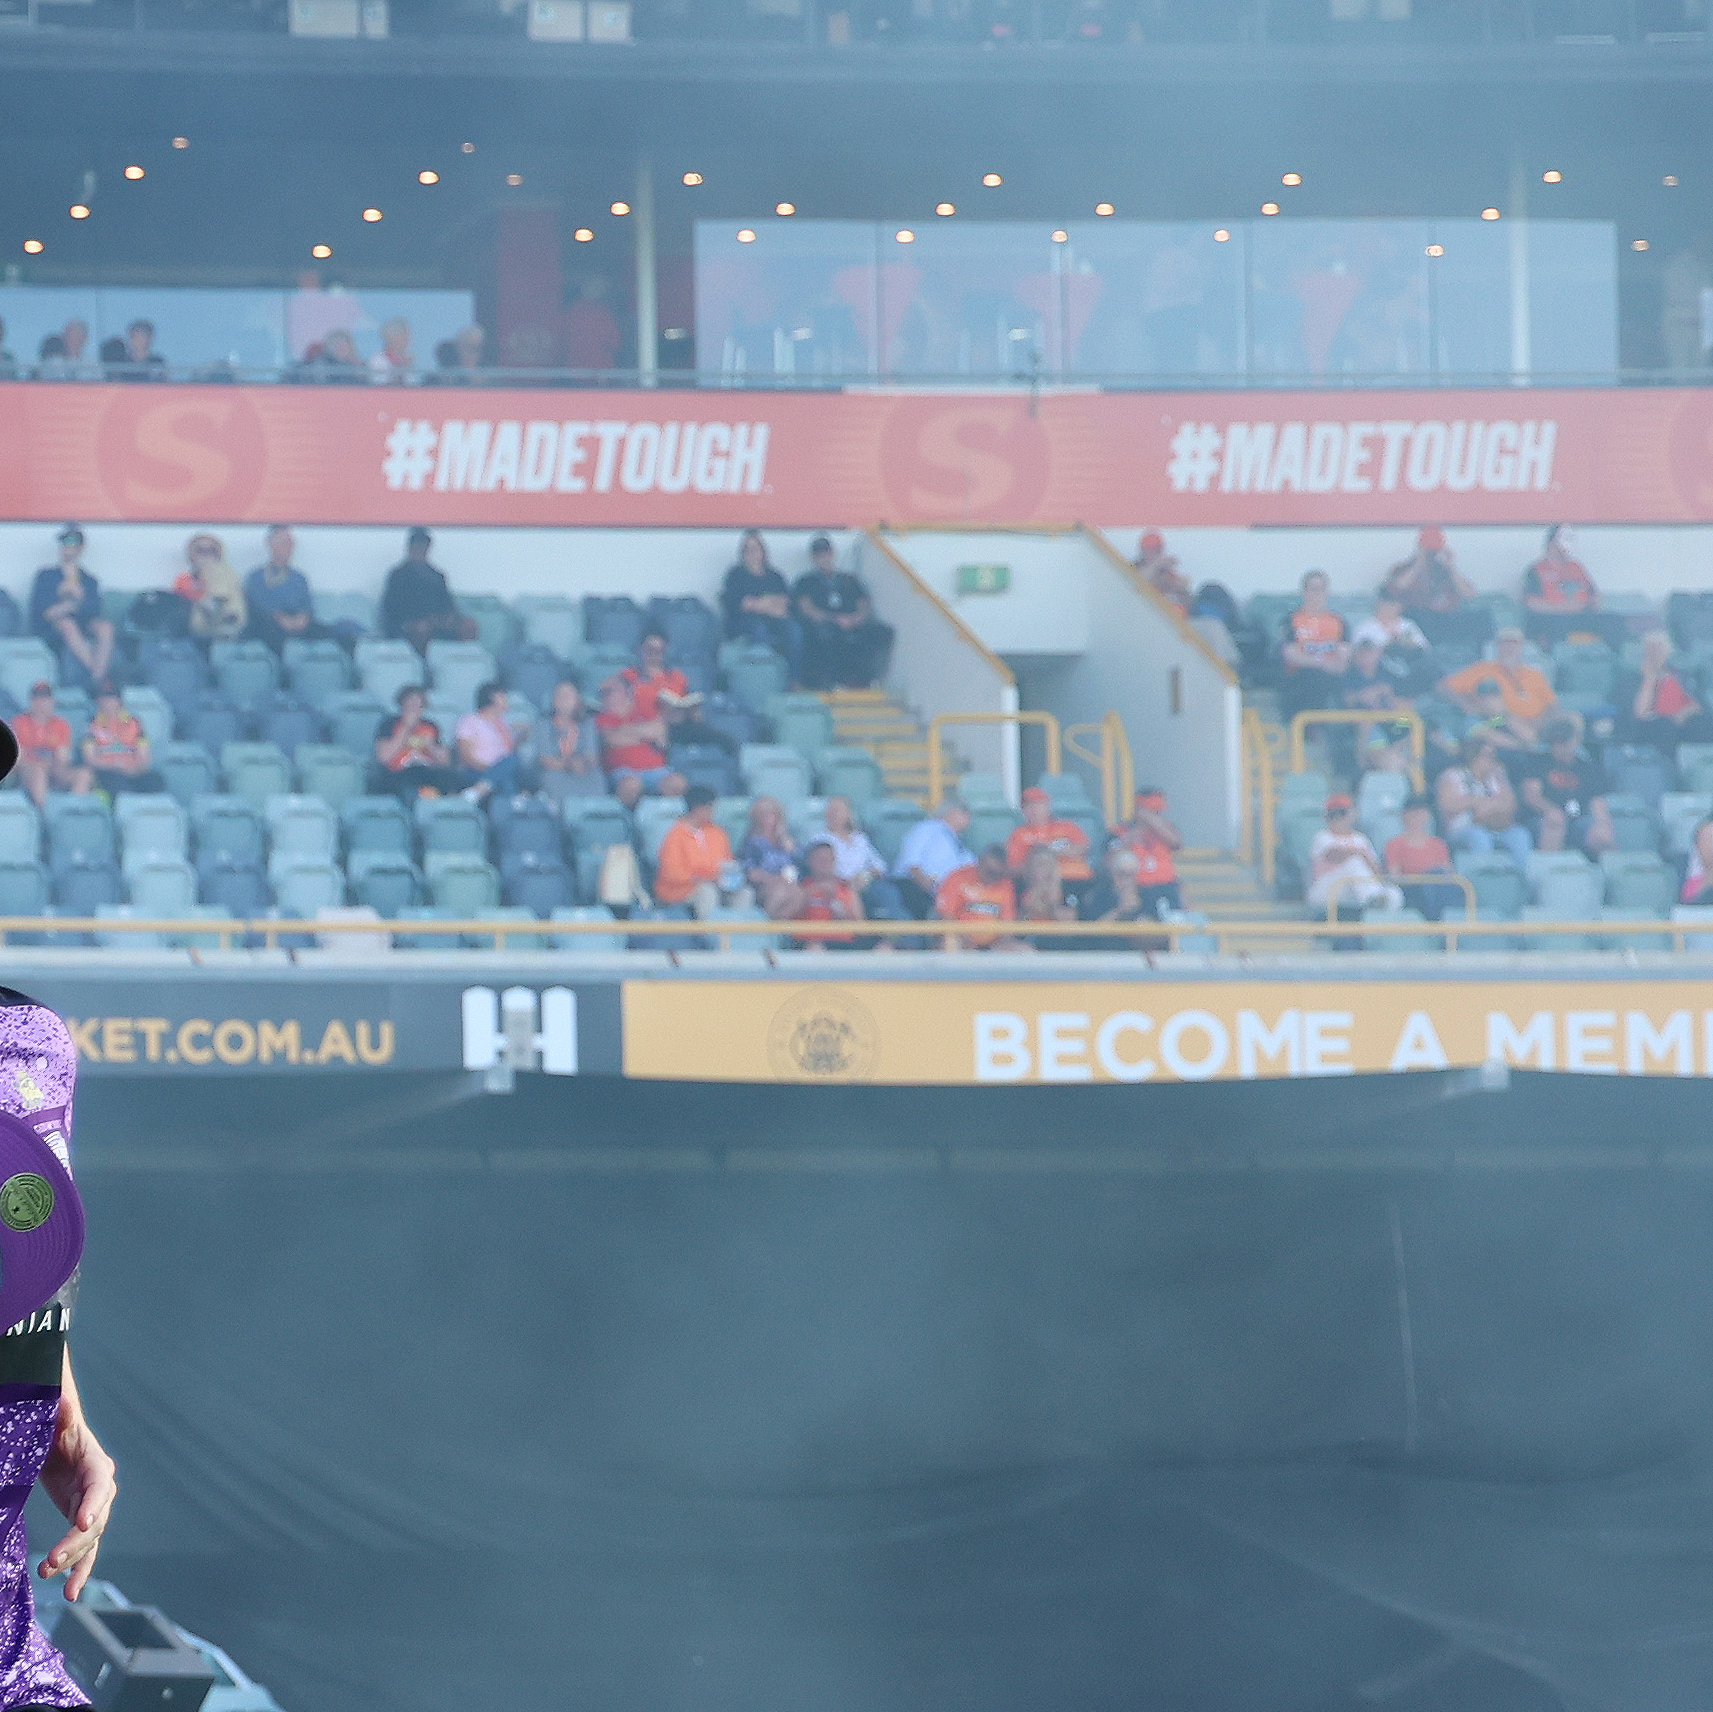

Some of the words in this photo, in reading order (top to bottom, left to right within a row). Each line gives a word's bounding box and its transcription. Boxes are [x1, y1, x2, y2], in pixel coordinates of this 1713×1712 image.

[383, 420, 771, 494] #MADETOUGH
[1167, 420, 1558, 493] #MADETOUGH
[73, 1017, 395, 1065] KET.COM.AU
[973, 1008, 1355, 1084] BECOME
[1388, 1010, 1451, 1073] A
